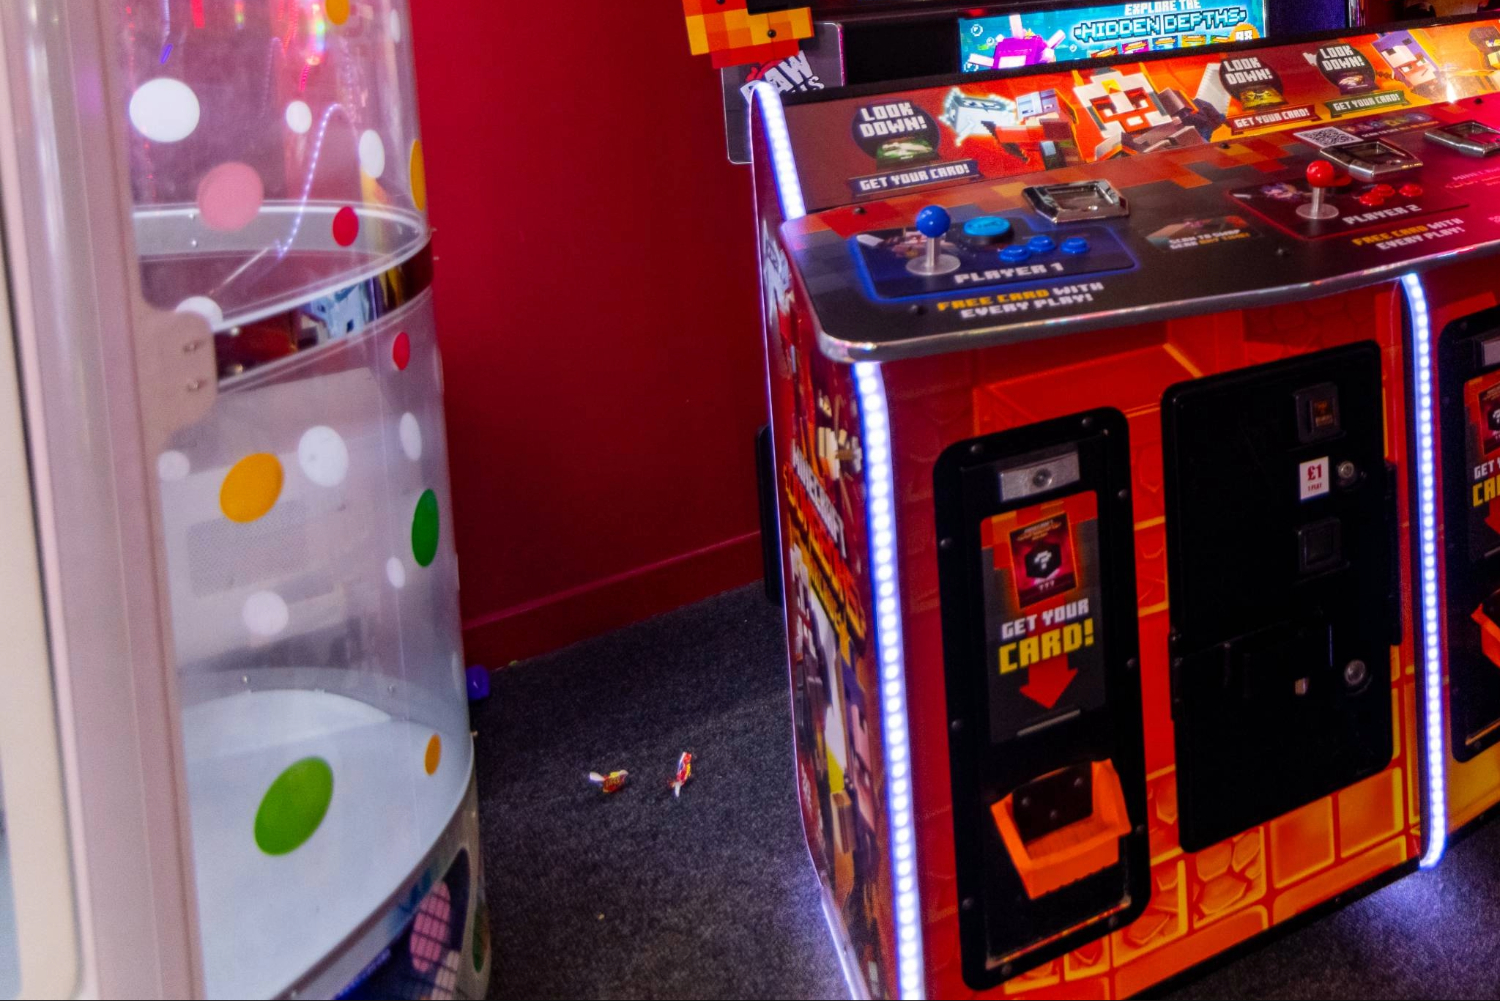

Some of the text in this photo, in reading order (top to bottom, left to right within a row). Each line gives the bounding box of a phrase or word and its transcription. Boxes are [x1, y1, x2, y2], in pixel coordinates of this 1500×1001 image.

[1124, 0, 1177, 16] EXPLORE
[1081, 7, 1241, 45] HIDDEN DEPTHS
[1319, 45, 1354, 60] LOOK
[1223, 57, 1262, 72] LOOK
[1322, 55, 1365, 72] DOWN!
[1225, 68, 1274, 86] DOWN!
[861, 102, 915, 121] LOOK
[1333, 93, 1401, 112] GET YOUR CARD!
[860, 115, 928, 138] DOWN!
[1234, 108, 1310, 128] GET YOUR CARD!
[860, 163, 970, 191] GET YOUR CARD!
[1342, 204, 1422, 225] PLAYER 2
[1352, 217, 1465, 247] FREE CARD WITH
[1374, 226, 1465, 250] EVERY PLAY!
[954, 262, 1064, 284] PLAYER 1
[937, 281, 1105, 312] FREE CARD WITH
[960, 293, 1095, 319] EVERY PLAY!
[1307, 464, 1323, 481] £1
[1474, 459, 1495, 480] GET
[1001, 598, 1090, 640] GET YOUR
[999, 618, 1094, 675] CARD!
